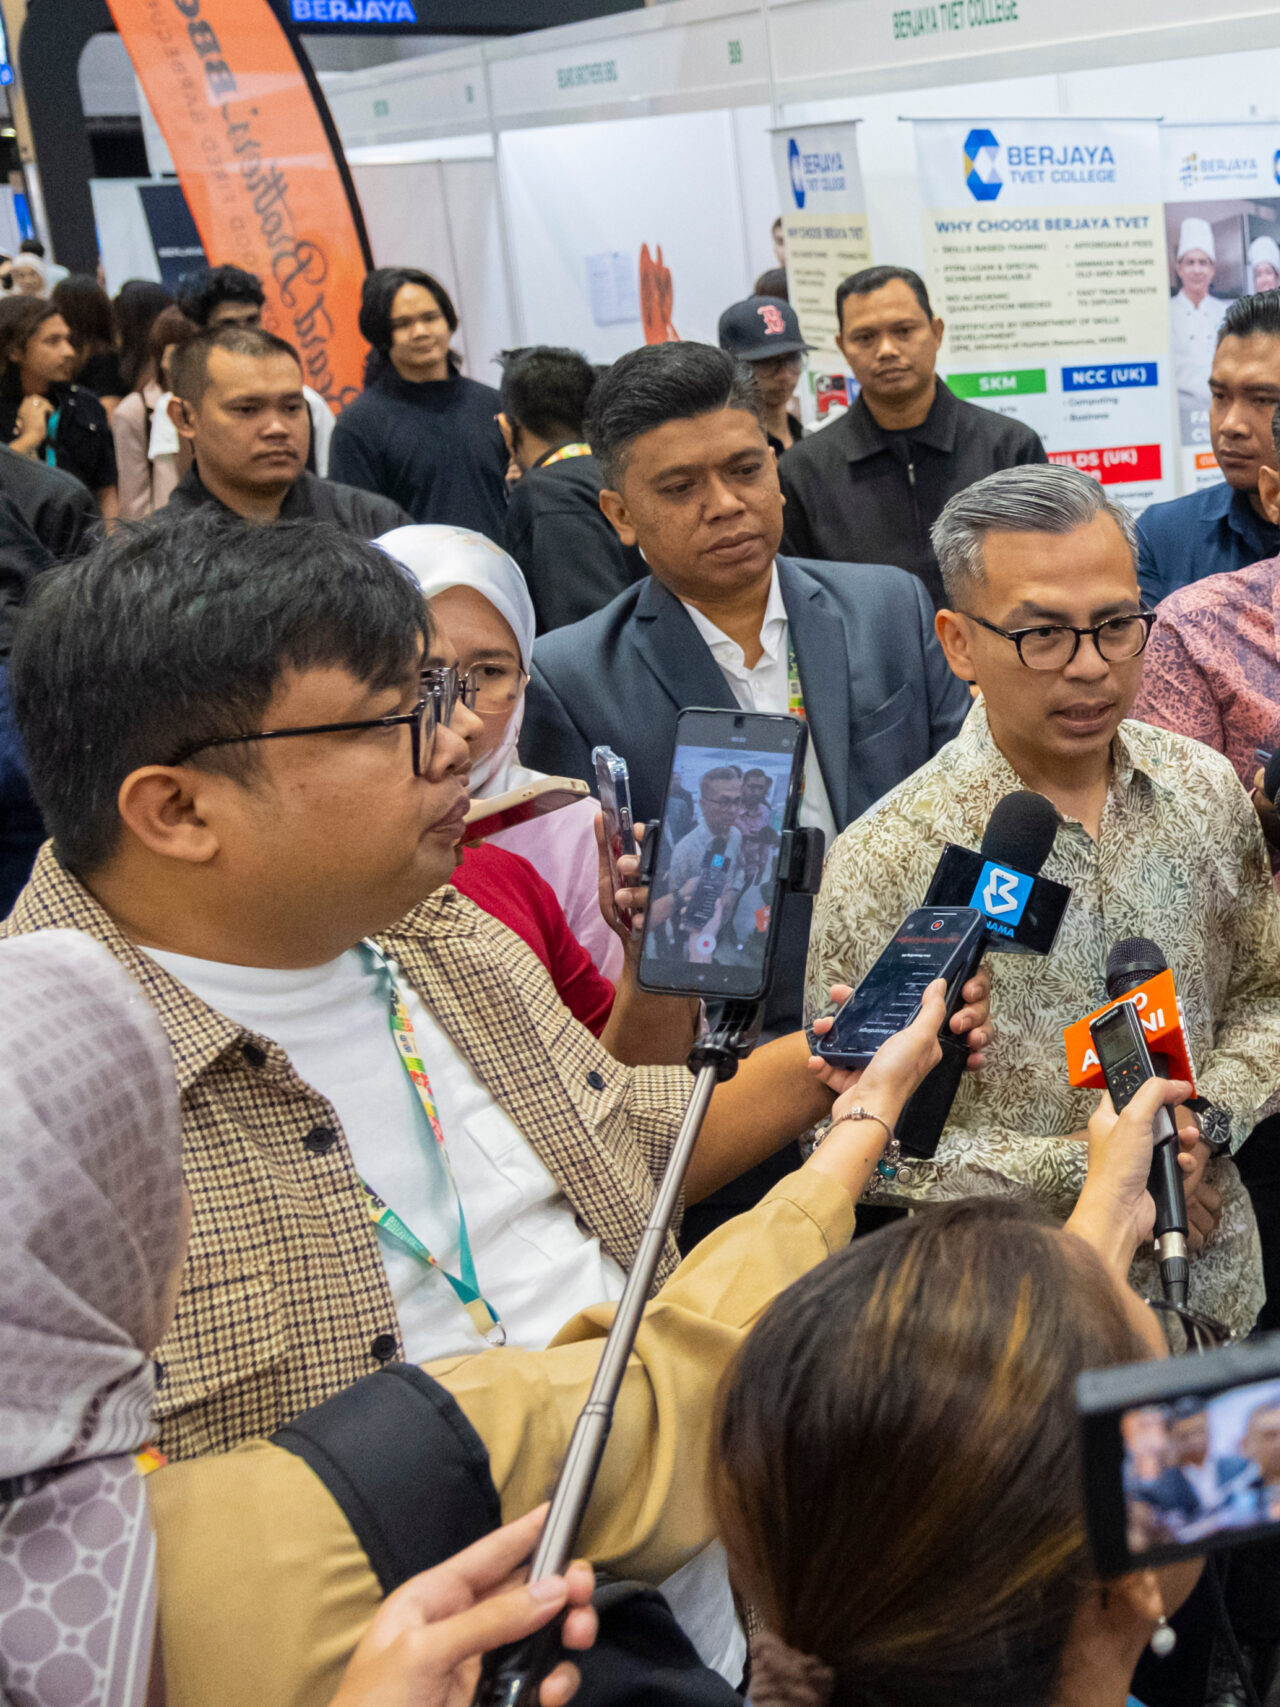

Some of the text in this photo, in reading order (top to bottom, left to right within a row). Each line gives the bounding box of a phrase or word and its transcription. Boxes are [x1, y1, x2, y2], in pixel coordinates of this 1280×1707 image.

[292, 0, 417, 22] BERJAYA
[893, 0, 1018, 40] BERJAYA TVET COLLEGE
[802, 151, 845, 175] BERJAYA
[1007, 145, 1116, 167] BERJAYA
[1200, 158, 1257, 172] BERJAYA
[1010, 169, 1117, 184] TVET COLLEGE
[935, 216, 1150, 234] WHY CHOOSE BERJAYA TVET
[942, 245, 972, 253] SKILLS
[1007, 243, 1047, 251] TRAINING
[1074, 240, 1129, 249] AFFORDABLE
[979, 376, 1017, 392] SKM
[1072, 366, 1147, 385] NCC (UK)
[1068, 395, 1119, 408] Computing
[1070, 411, 1110, 423] Business
[1048, 447, 1138, 469] UILDS (UK)
[986, 920, 1015, 939] NAMA
[1095, 1008, 1119, 1027] OLYMPUS
[1081, 1008, 1166, 1073] ANI
